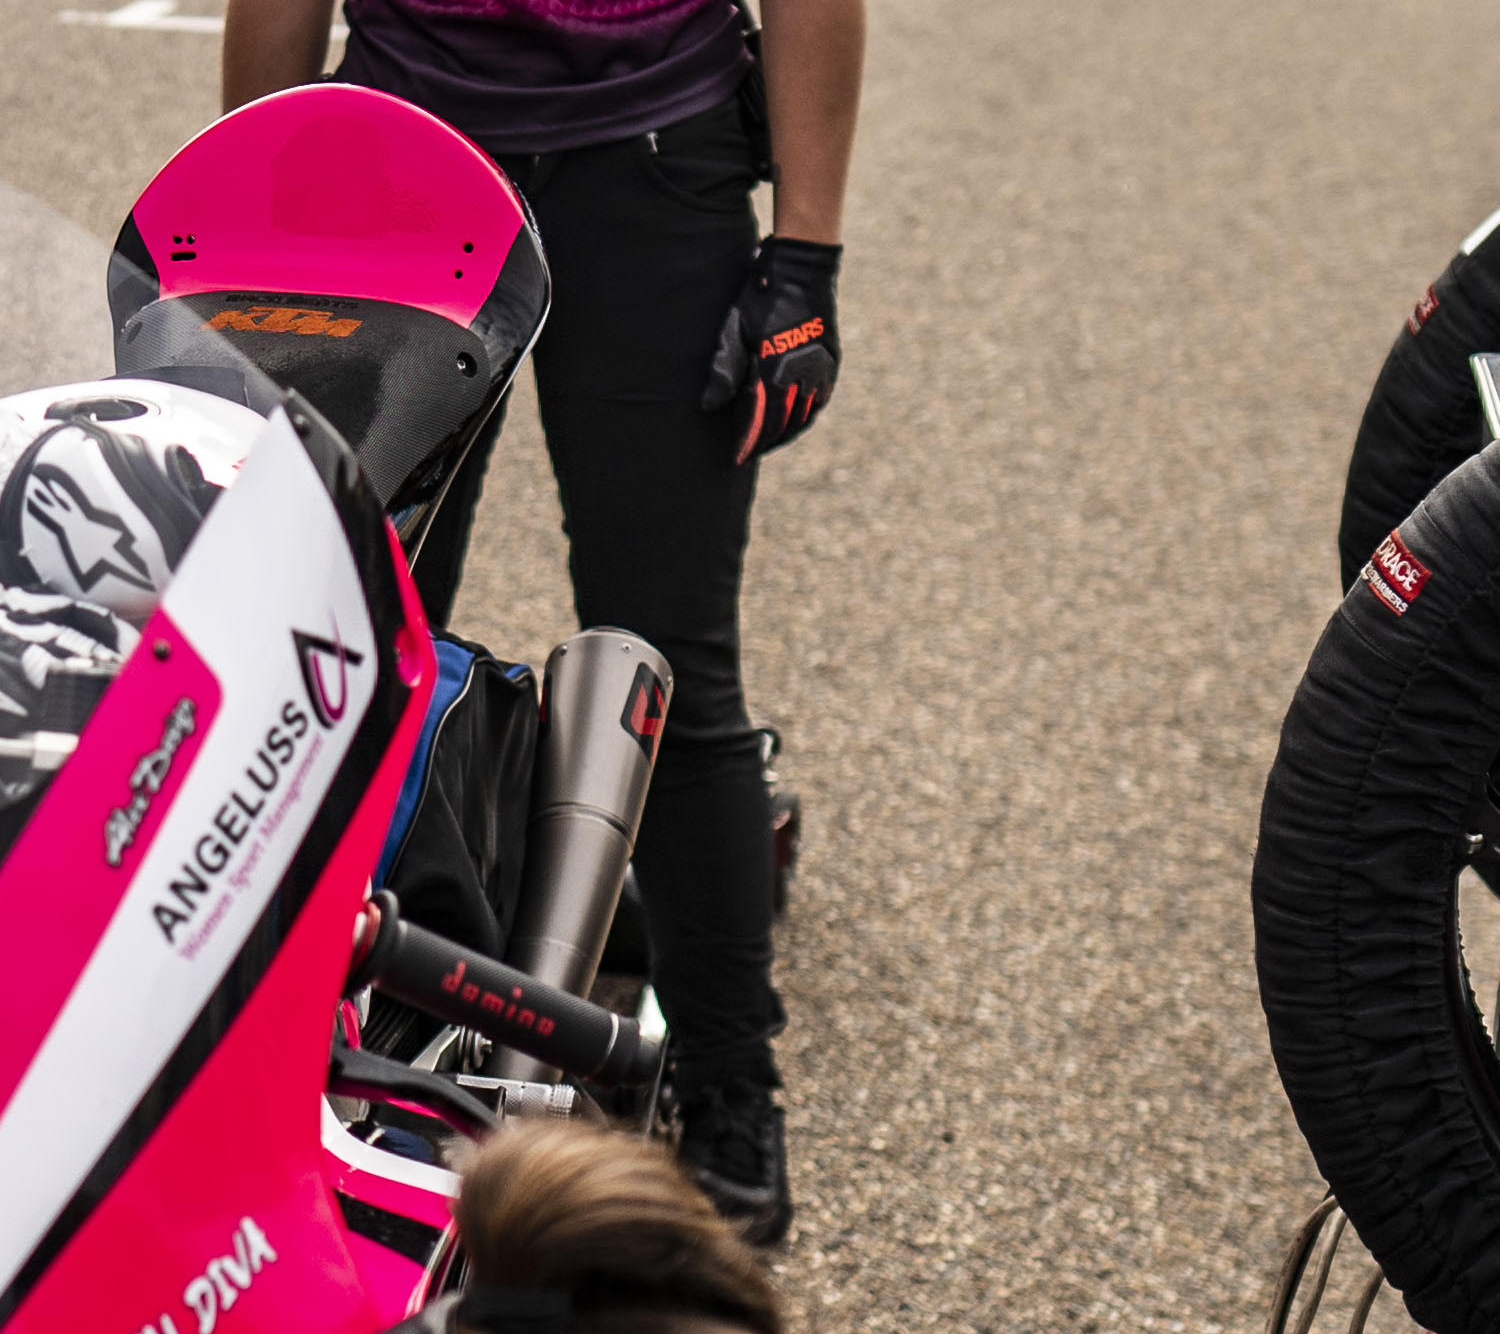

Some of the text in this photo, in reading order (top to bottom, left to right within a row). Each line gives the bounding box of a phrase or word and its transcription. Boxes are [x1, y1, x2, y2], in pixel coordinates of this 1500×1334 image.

[196, 306, 364, 339] KTM
[760, 316, 824, 360] ASTARS
[151, 698, 312, 945] ANGELUSS
[440, 959, 556, 1037] domino
